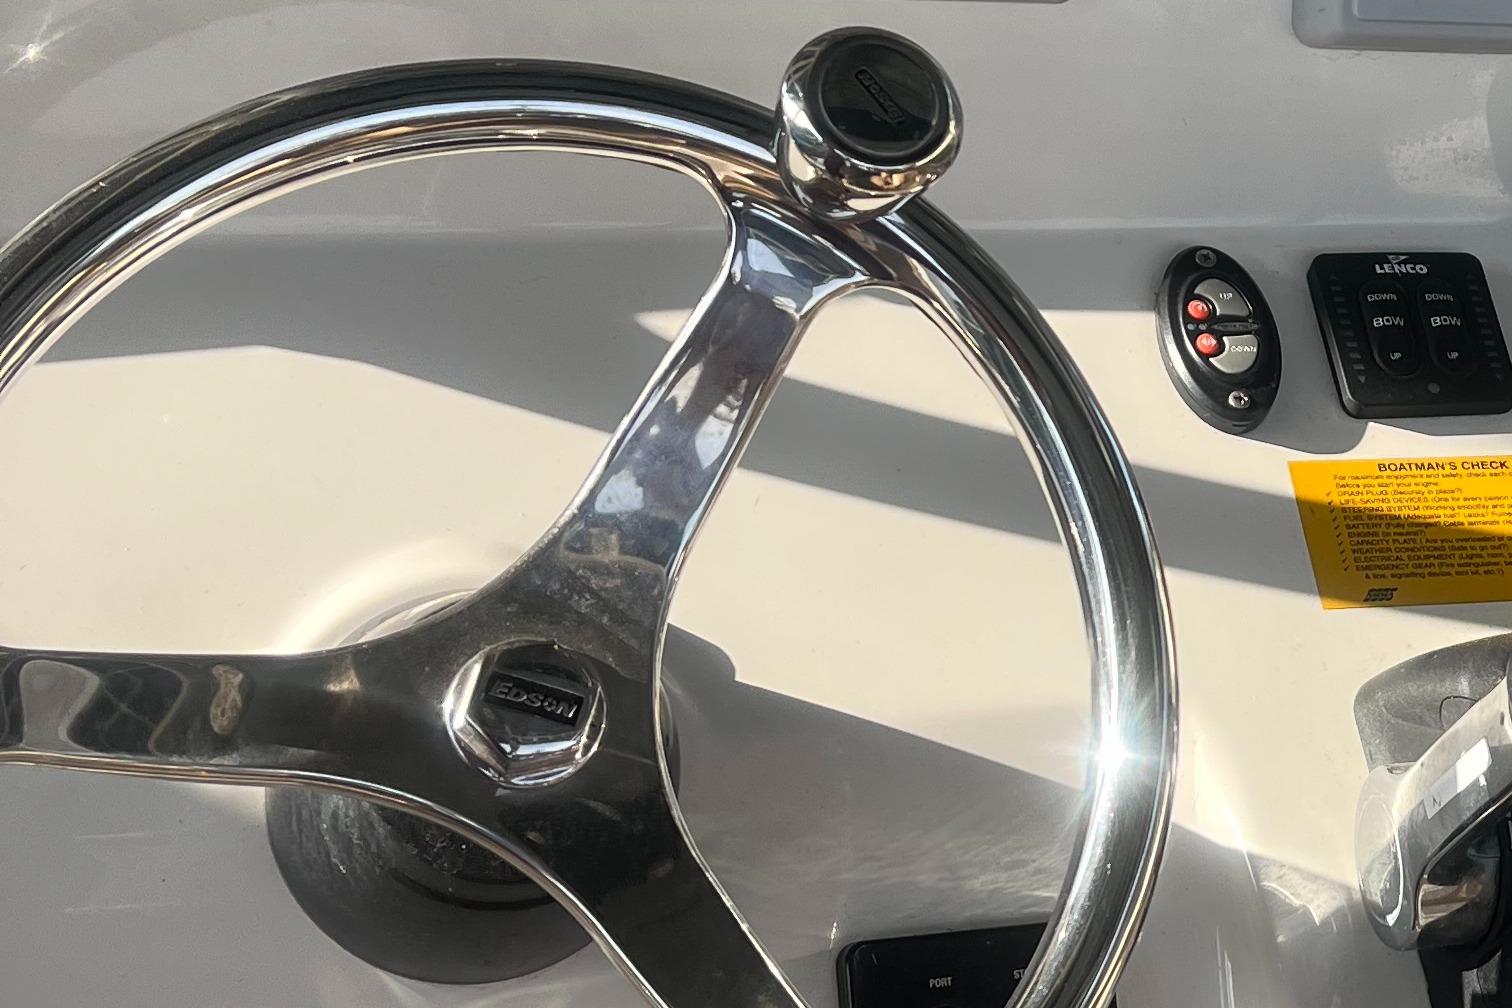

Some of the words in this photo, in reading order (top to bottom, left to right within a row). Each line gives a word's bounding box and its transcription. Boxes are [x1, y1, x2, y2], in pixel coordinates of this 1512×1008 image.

[1375, 263, 1428, 275] LENCO
[1219, 292, 1233, 300] UP
[1367, 293, 1398, 303] DOWN
[1425, 293, 1454, 303] DOWN
[1372, 316, 1405, 328] BOW
[1430, 316, 1462, 328] BOW
[1390, 352, 1402, 361] UP
[1447, 351, 1459, 361] UP
[1377, 461, 1457, 472] BOATMAN'S
[1461, 460, 1509, 470] CHECK
[488, 681, 578, 718] EDSON
[929, 977, 952, 988] PORT
